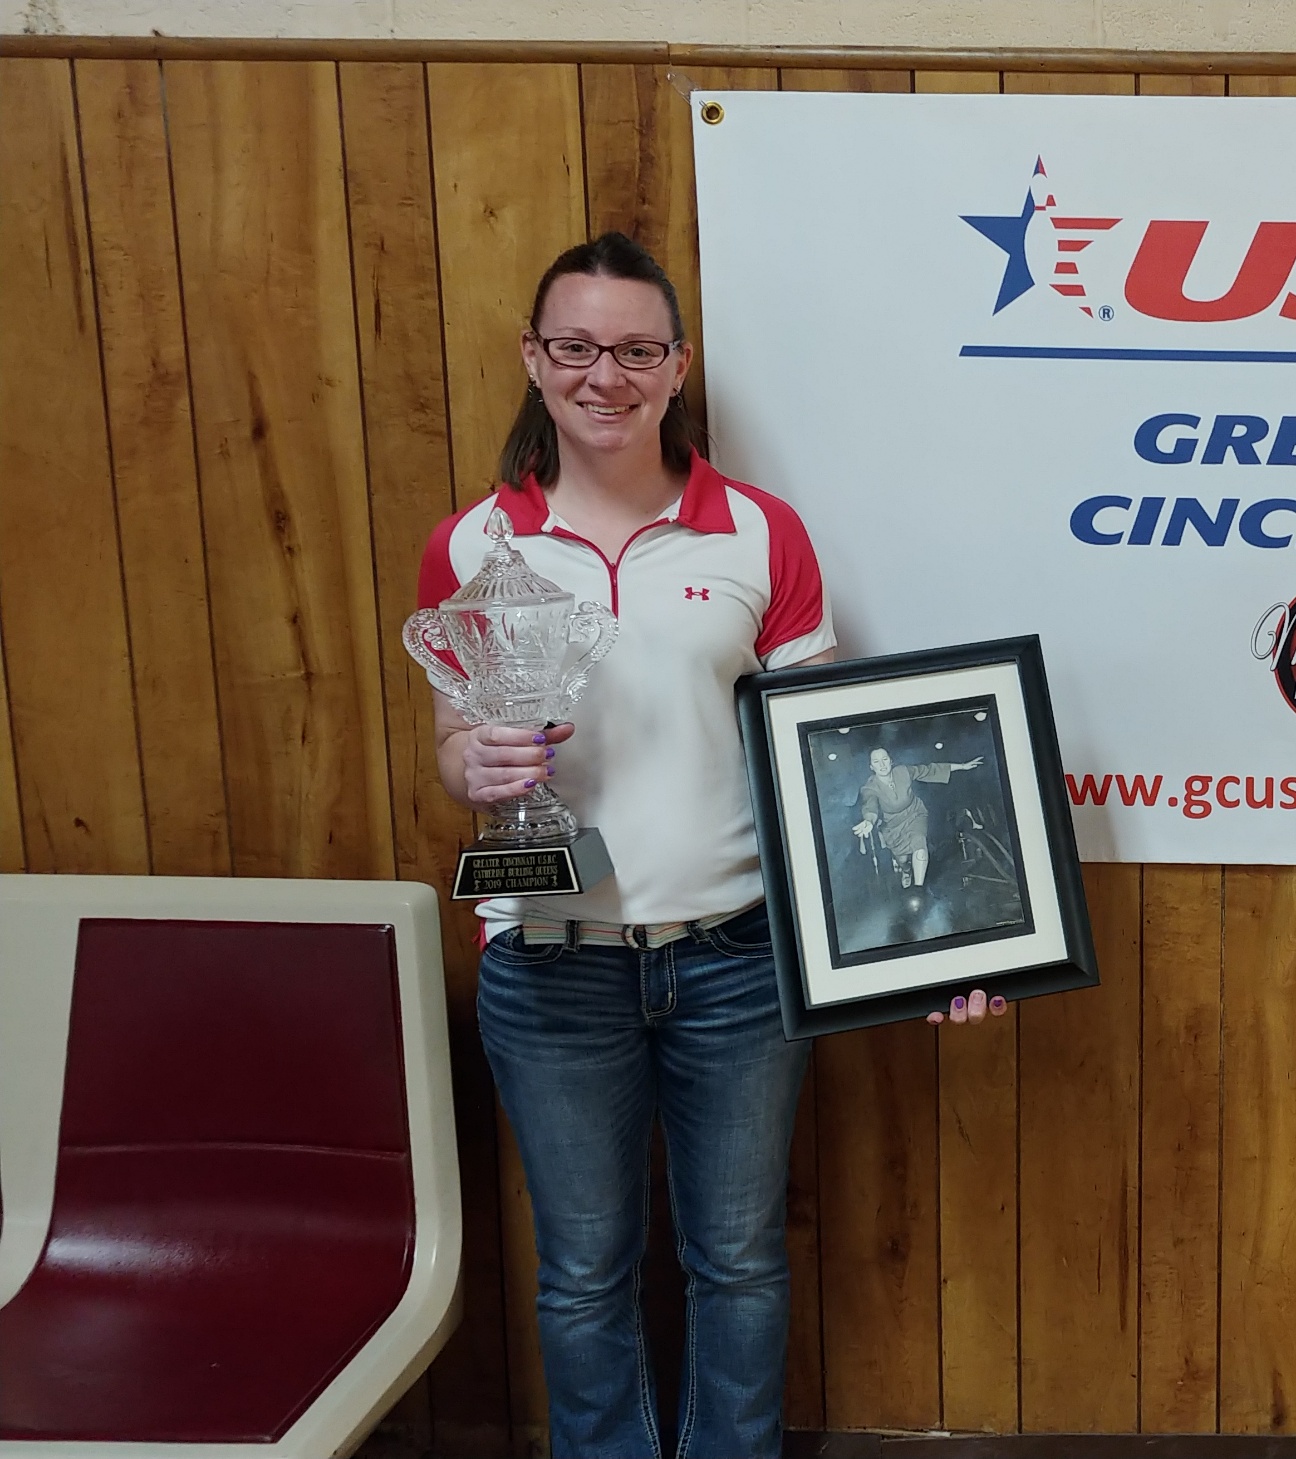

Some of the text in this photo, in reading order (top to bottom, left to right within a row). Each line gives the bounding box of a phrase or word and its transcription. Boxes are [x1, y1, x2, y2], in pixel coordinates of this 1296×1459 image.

[473, 859, 500, 868] GREATER
[502, 856, 536, 867] CINCINNATI
[473, 868, 505, 879] CATHERINE
[535, 865, 558, 875] QUEENS
[483, 876, 549, 889] 2019 CHAMPION
